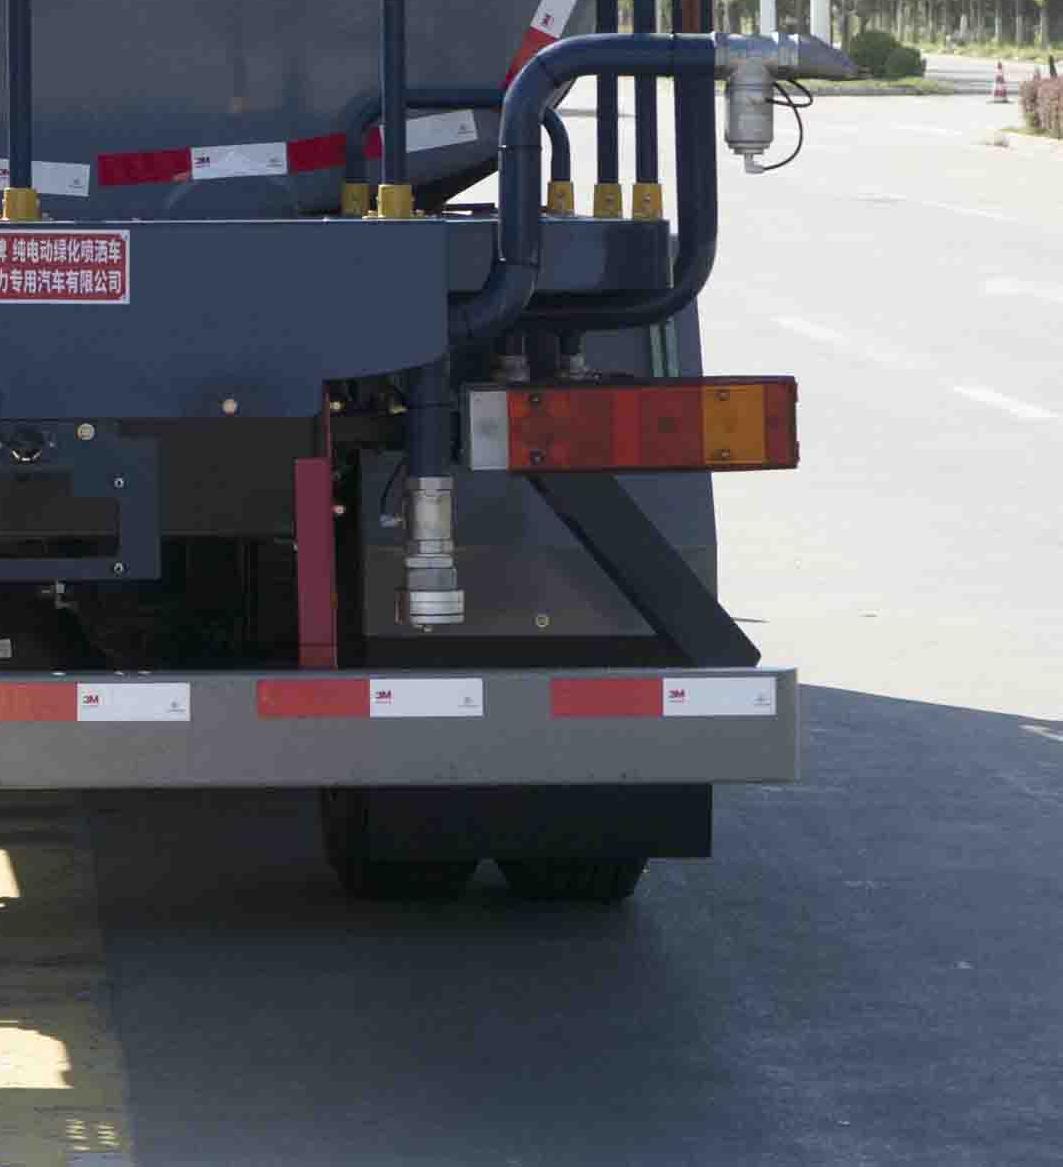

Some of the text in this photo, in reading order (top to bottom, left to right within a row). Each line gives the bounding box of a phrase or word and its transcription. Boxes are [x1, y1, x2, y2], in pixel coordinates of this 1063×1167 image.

[11, 239, 123, 264] 纯电动绿化喷洒车
[375, 690, 392, 699] 3M
[668, 689, 685, 698] 3M
[82, 695, 99, 704] 3M
